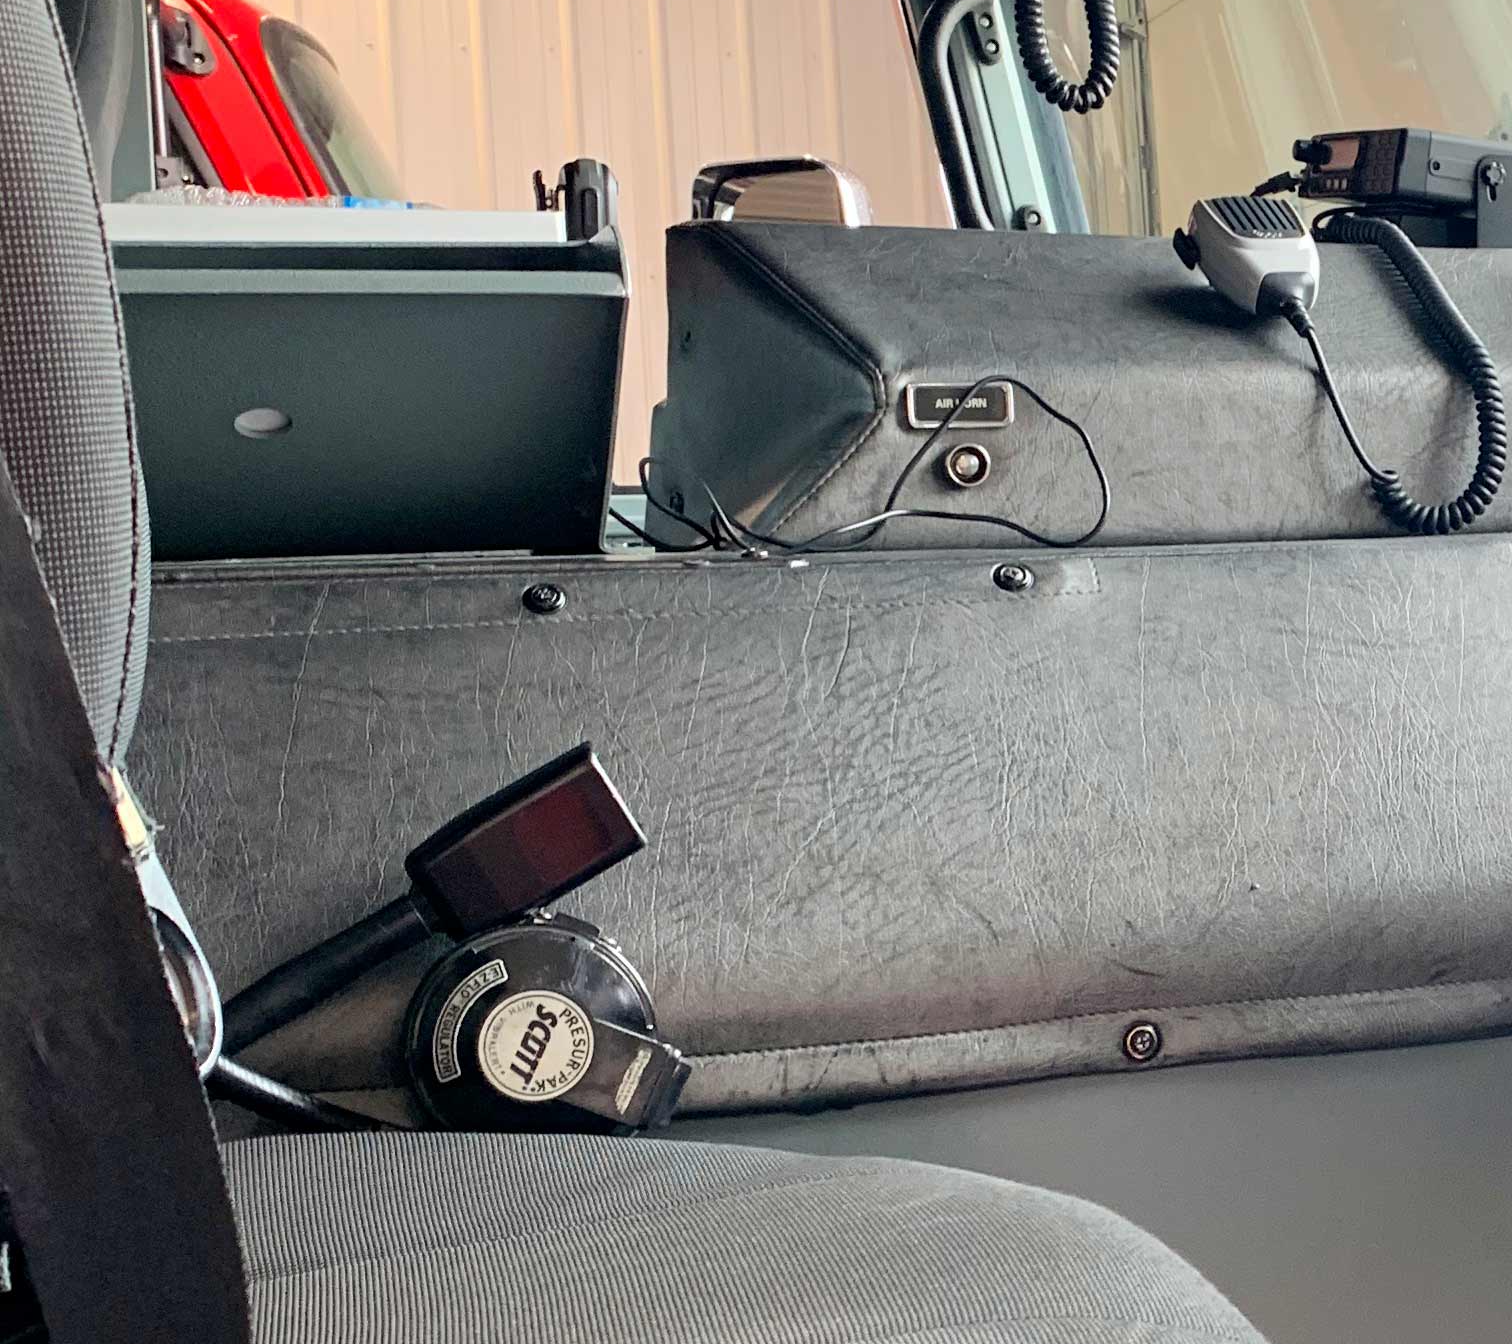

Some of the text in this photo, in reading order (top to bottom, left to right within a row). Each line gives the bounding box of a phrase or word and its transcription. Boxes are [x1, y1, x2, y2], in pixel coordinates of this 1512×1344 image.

[935, 398, 954, 409] AIR
[439, 1005, 460, 1073] REGULATOR
[510, 1003, 558, 1085] SCOTT
